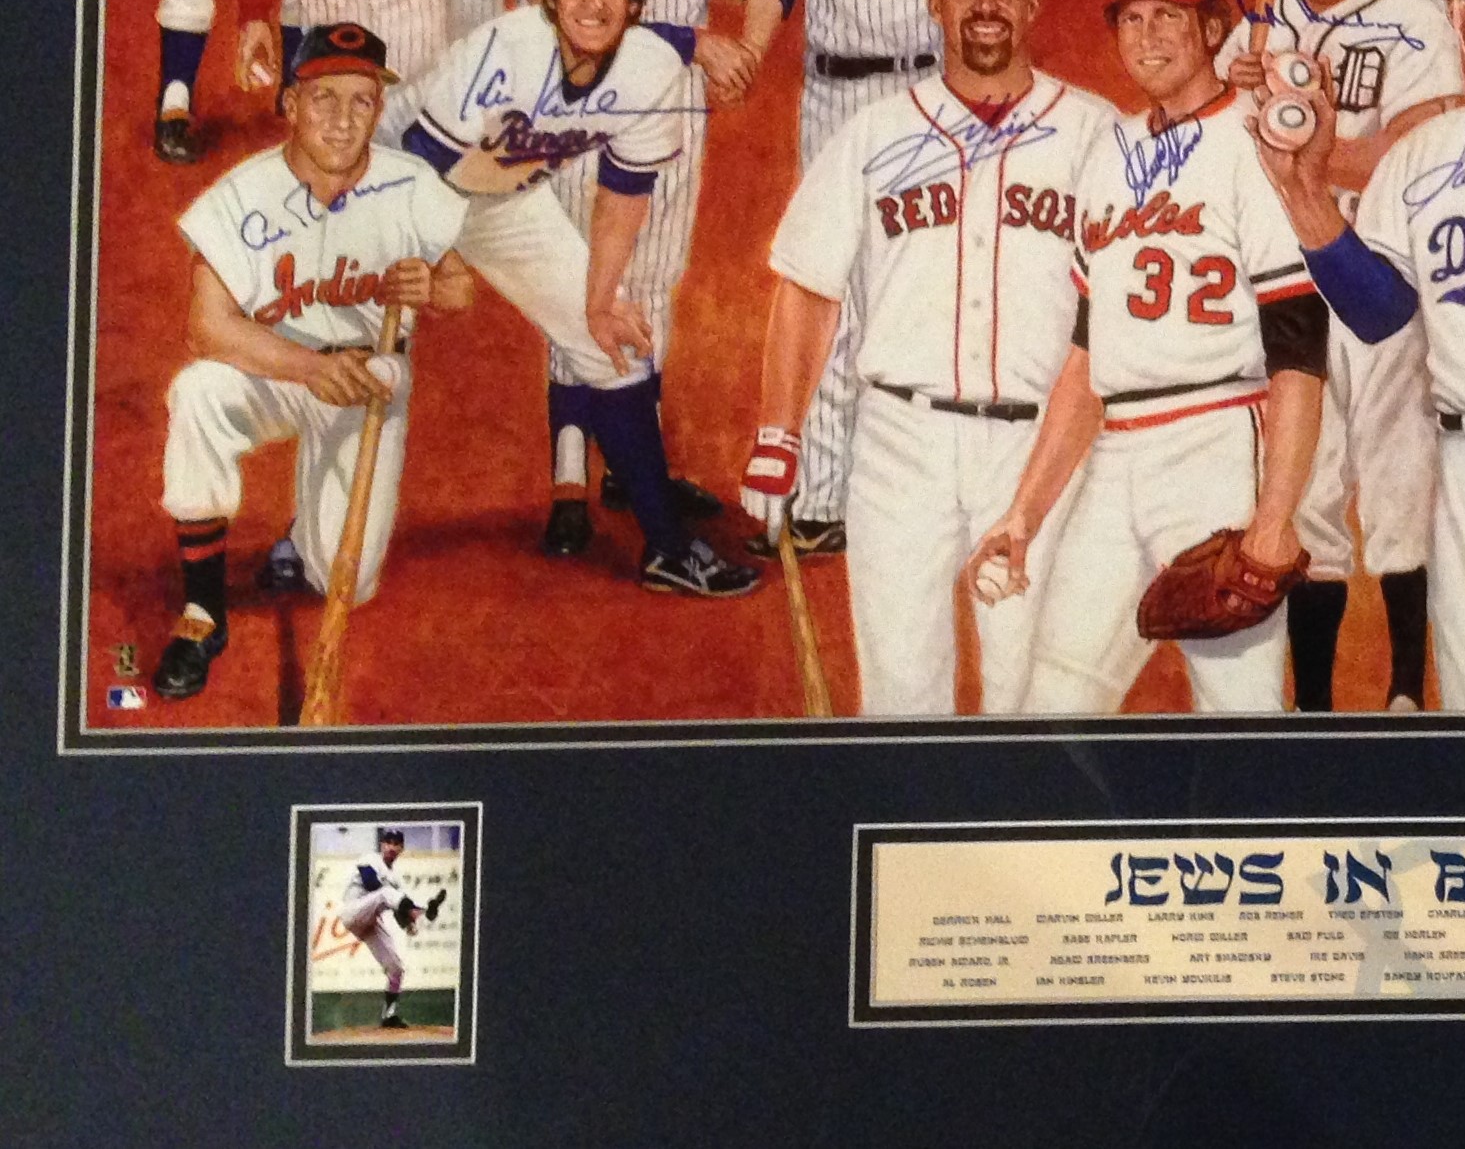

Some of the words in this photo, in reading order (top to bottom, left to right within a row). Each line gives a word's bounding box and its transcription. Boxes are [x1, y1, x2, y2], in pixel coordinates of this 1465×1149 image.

[876, 183, 958, 238] RED
[1126, 248, 1238, 325] 32
[1104, 851, 1285, 906] JEWS
[1323, 849, 1392, 904] IN
